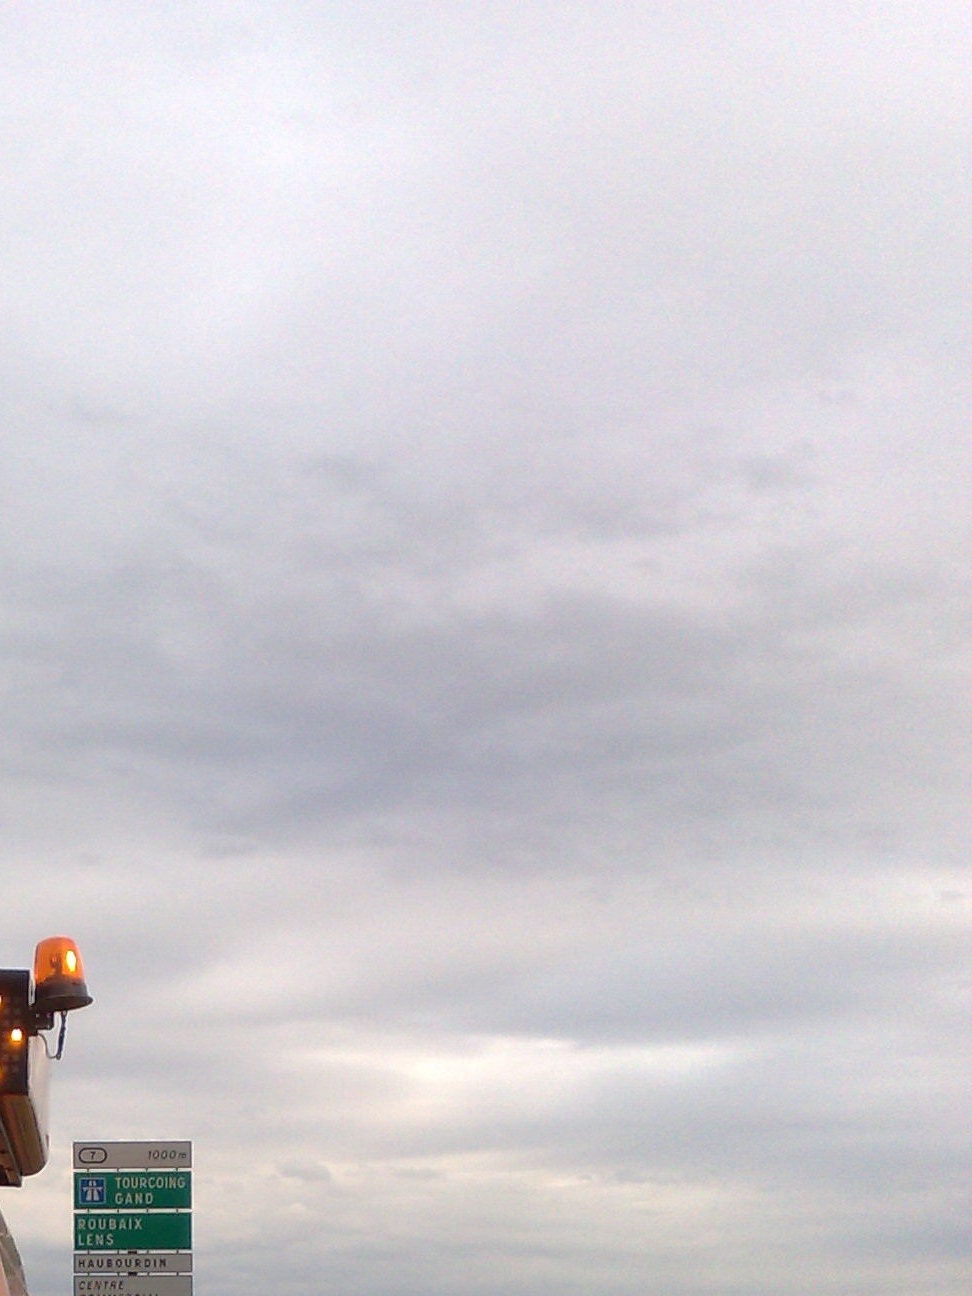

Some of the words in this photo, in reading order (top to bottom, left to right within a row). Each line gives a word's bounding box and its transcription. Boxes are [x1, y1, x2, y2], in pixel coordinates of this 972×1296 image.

[115, 1176, 186, 1189] TOURCOING
[114, 1192, 154, 1205] GAND
[78, 1218, 143, 1231] ROUBAIX
[78, 1234, 115, 1246] LENS
[78, 1258, 167, 1268] HAUBOURDIN
[78, 1280, 124, 1290] CENTRE
